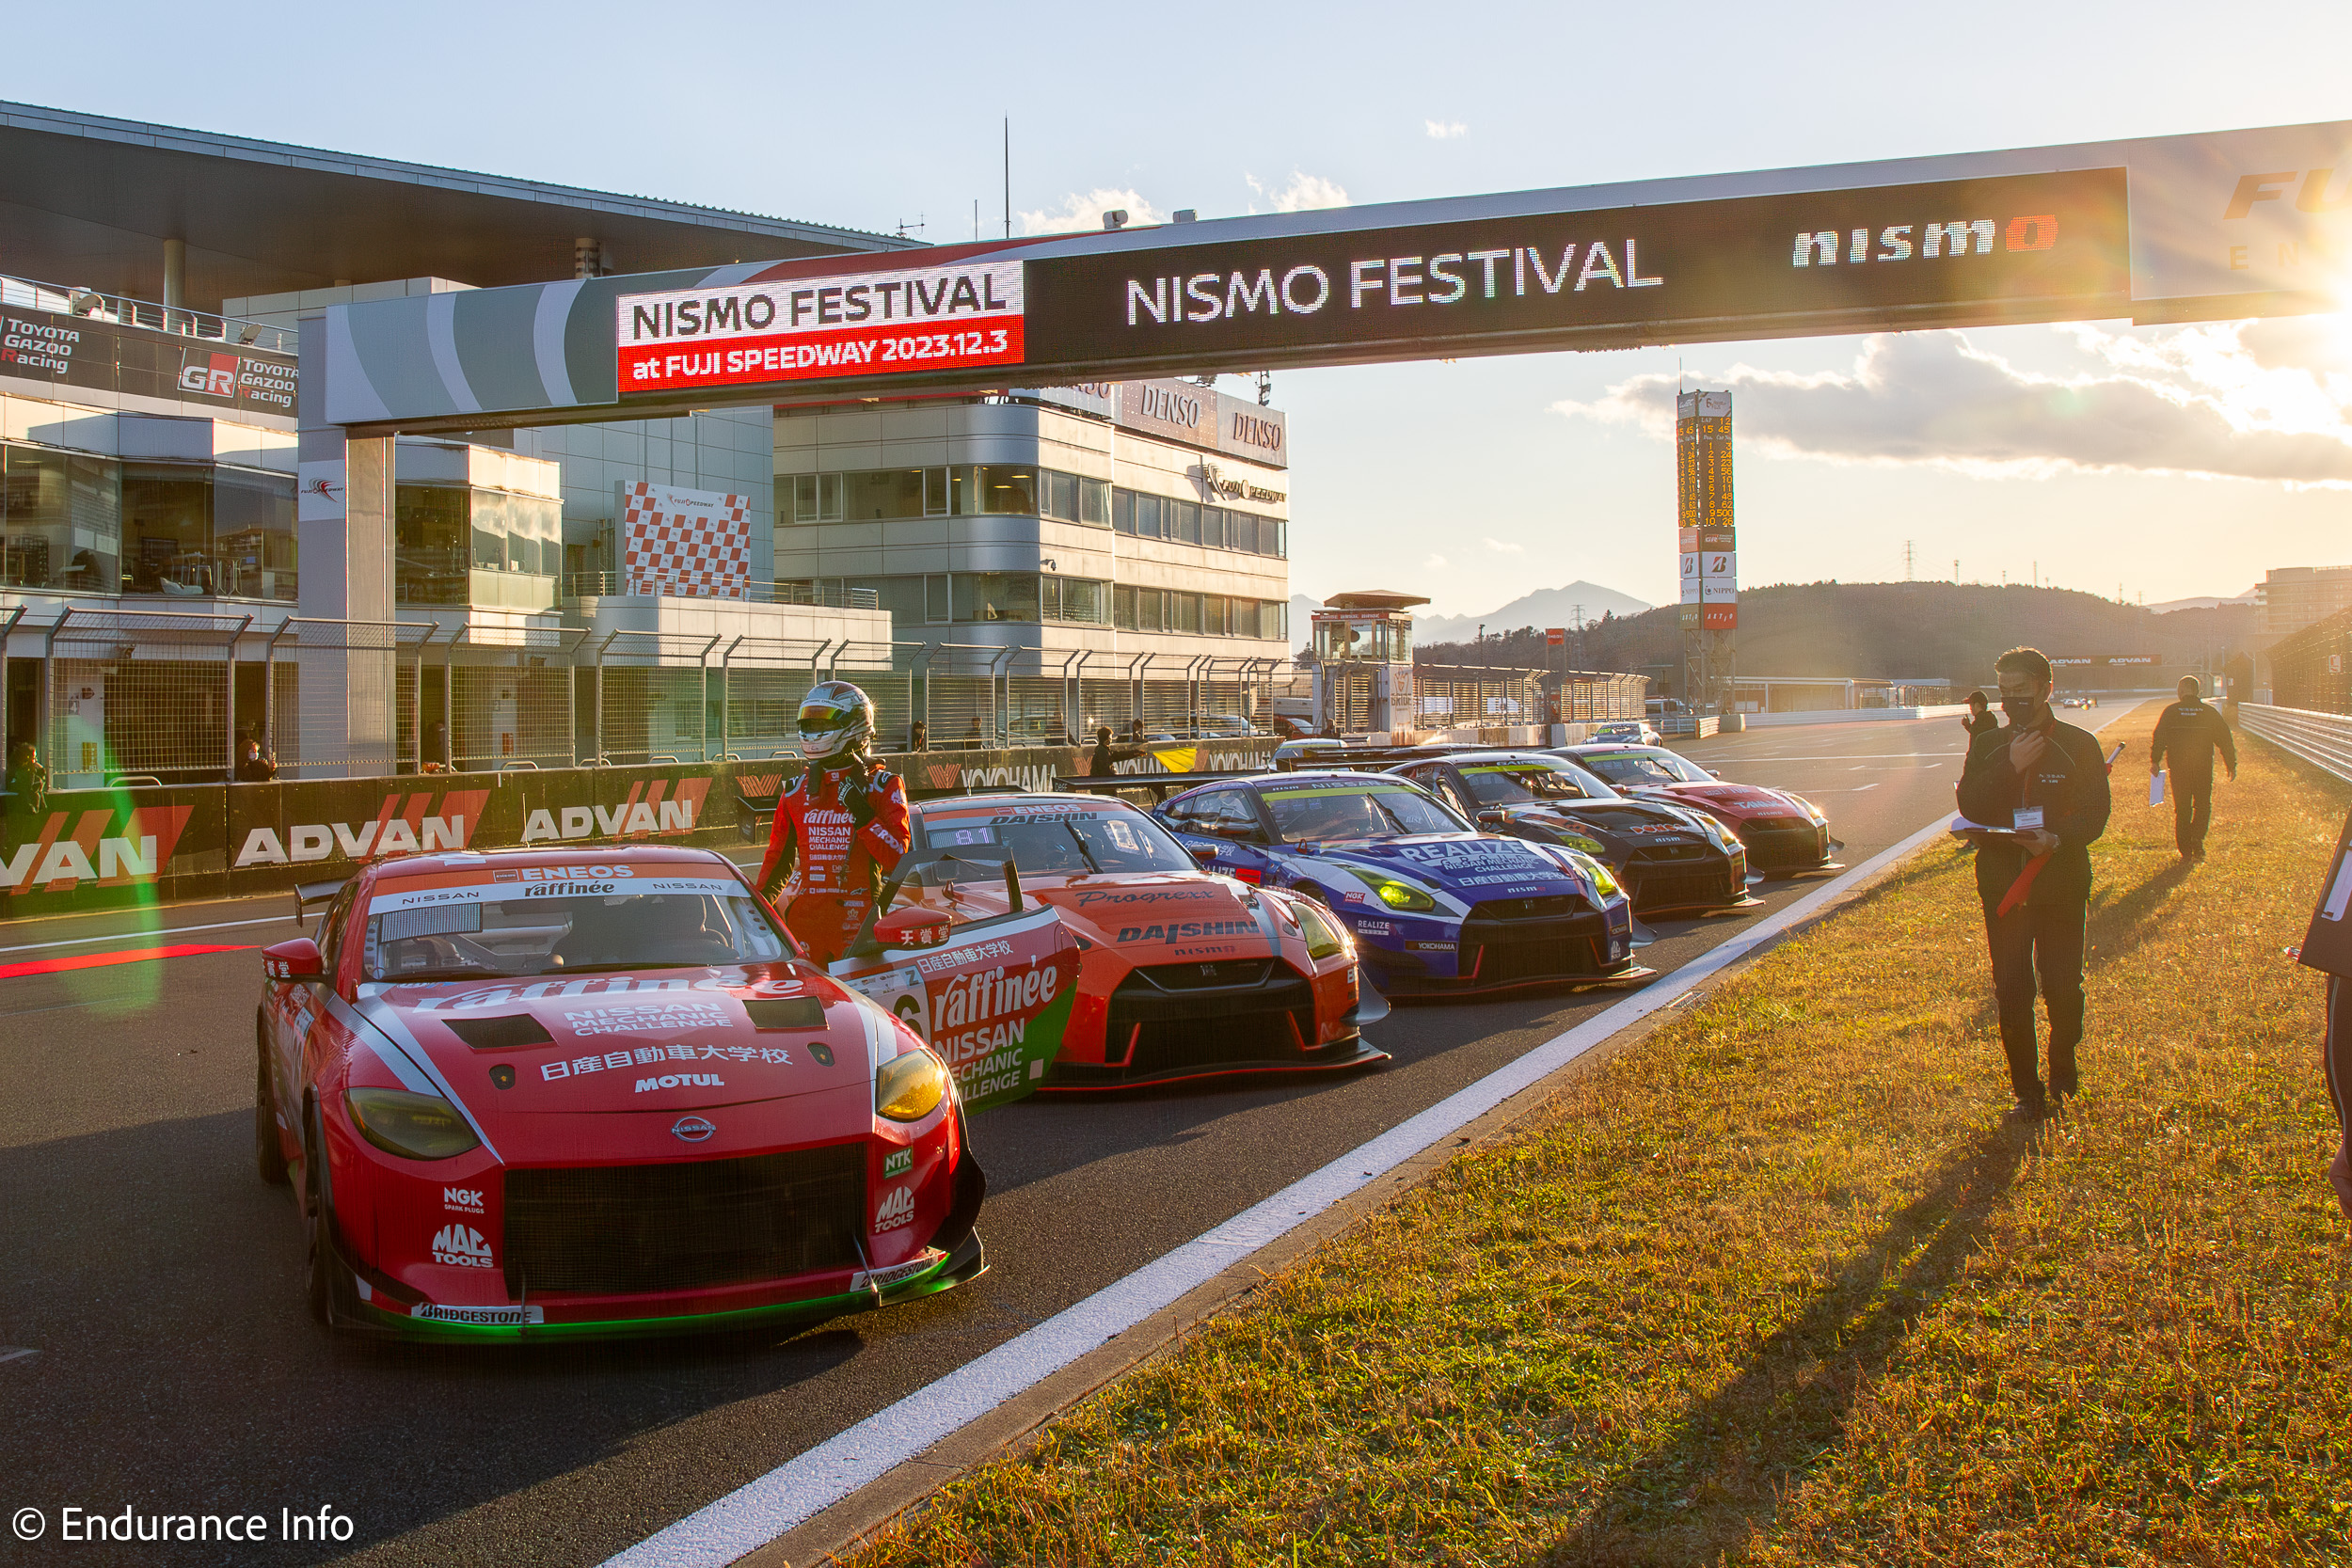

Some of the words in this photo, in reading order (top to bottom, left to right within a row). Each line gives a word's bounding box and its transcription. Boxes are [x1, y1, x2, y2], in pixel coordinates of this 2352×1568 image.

[1792, 214, 2059, 268] nismo
[1128, 264, 1329, 325] NISMO
[1350, 239, 1664, 308] FESTIVAL
[632, 293, 776, 340] NISMO
[790, 273, 1007, 324] FESTIVAL
[7, 317, 80, 342] TOYOTA
[4, 334, 72, 356] GAZOO
[633, 358, 660, 378] at
[665, 352, 721, 377] FUJI
[726, 340, 879, 373] SPEEDWAY
[882, 329, 1008, 361] 2023.12.3
[1, 348, 68, 374] Racing
[182, 365, 234, 395] GR
[240, 372, 295, 391] GAZOO
[240, 388, 292, 408] Racing
[1141, 384, 1200, 429] DENSO
[1702, 425, 1714, 434] 15
[1718, 425, 1730, 434] 45
[1720, 417, 1731, 425] 12
[1233, 412, 1283, 451] DENSO
[1725, 442, 1732, 451] 3
[1721, 467, 1732, 475] 56
[1722, 475, 1732, 483] 10
[1222, 481, 1241, 497] FUJI
[1721, 492, 1733, 500] 48
[1722, 483, 1731, 492] 11
[1716, 509, 1733, 517] 500
[1721, 500, 1733, 509] 62
[1722, 517, 1733, 526] 26
[961, 764, 1057, 792] YOKOHAMA
[1311, 780, 1382, 790] NISSAN
[990, 813, 1097, 825] DAISHIN
[1014, 803, 1081, 815] ENEOS
[522, 800, 695, 842] ADVAN
[233, 815, 465, 867] ADVAN
[809, 827, 850, 836] NISSAN
[955, 828, 989, 846] 81
[1399, 840, 1528, 862] REALIZE
[522, 865, 635, 880] ENEOS
[1444, 858, 1486, 870] NISSAN
[1475, 864, 1535, 873] CHALLENGE
[402, 891, 480, 905] NISSAN
[652, 881, 723, 892] NISSAN
[1345, 892, 1363, 900] NGK
[1117, 920, 1261, 944] DAISHIN
[1358, 920, 1390, 929] REALIZE
[900, 925, 949, 946] 天賞堂
[917, 940, 1014, 974] 日産自動車大学校
[905, 970, 919, 987] Z
[564, 1003, 723, 1022] NISSAN
[572, 1011, 729, 1027] MECHANIC
[575, 1019, 733, 1037] CHALLENGE
[935, 1018, 1025, 1063] NISSAN
[540, 1044, 793, 1082] 日産自動車大学校
[952, 1048, 1023, 1083] ECHANIC
[634, 1073, 724, 1094] MOTUL
[958, 1070, 1020, 1102] ALLENGE
[671, 1124, 717, 1134] NISSAN
[885, 1148, 911, 1171] NTK
[444, 1187, 484, 1207] NGK
[876, 1185, 914, 1223] MAC
[444, 1204, 463, 1212] SPARK
[464, 1206, 485, 1214] PLUGS
[875, 1211, 914, 1233] TOOLS
[433, 1224, 492, 1257] MAC
[432, 1251, 494, 1268] TOOLS
[421, 1302, 532, 1323] BRIDGESTONE
